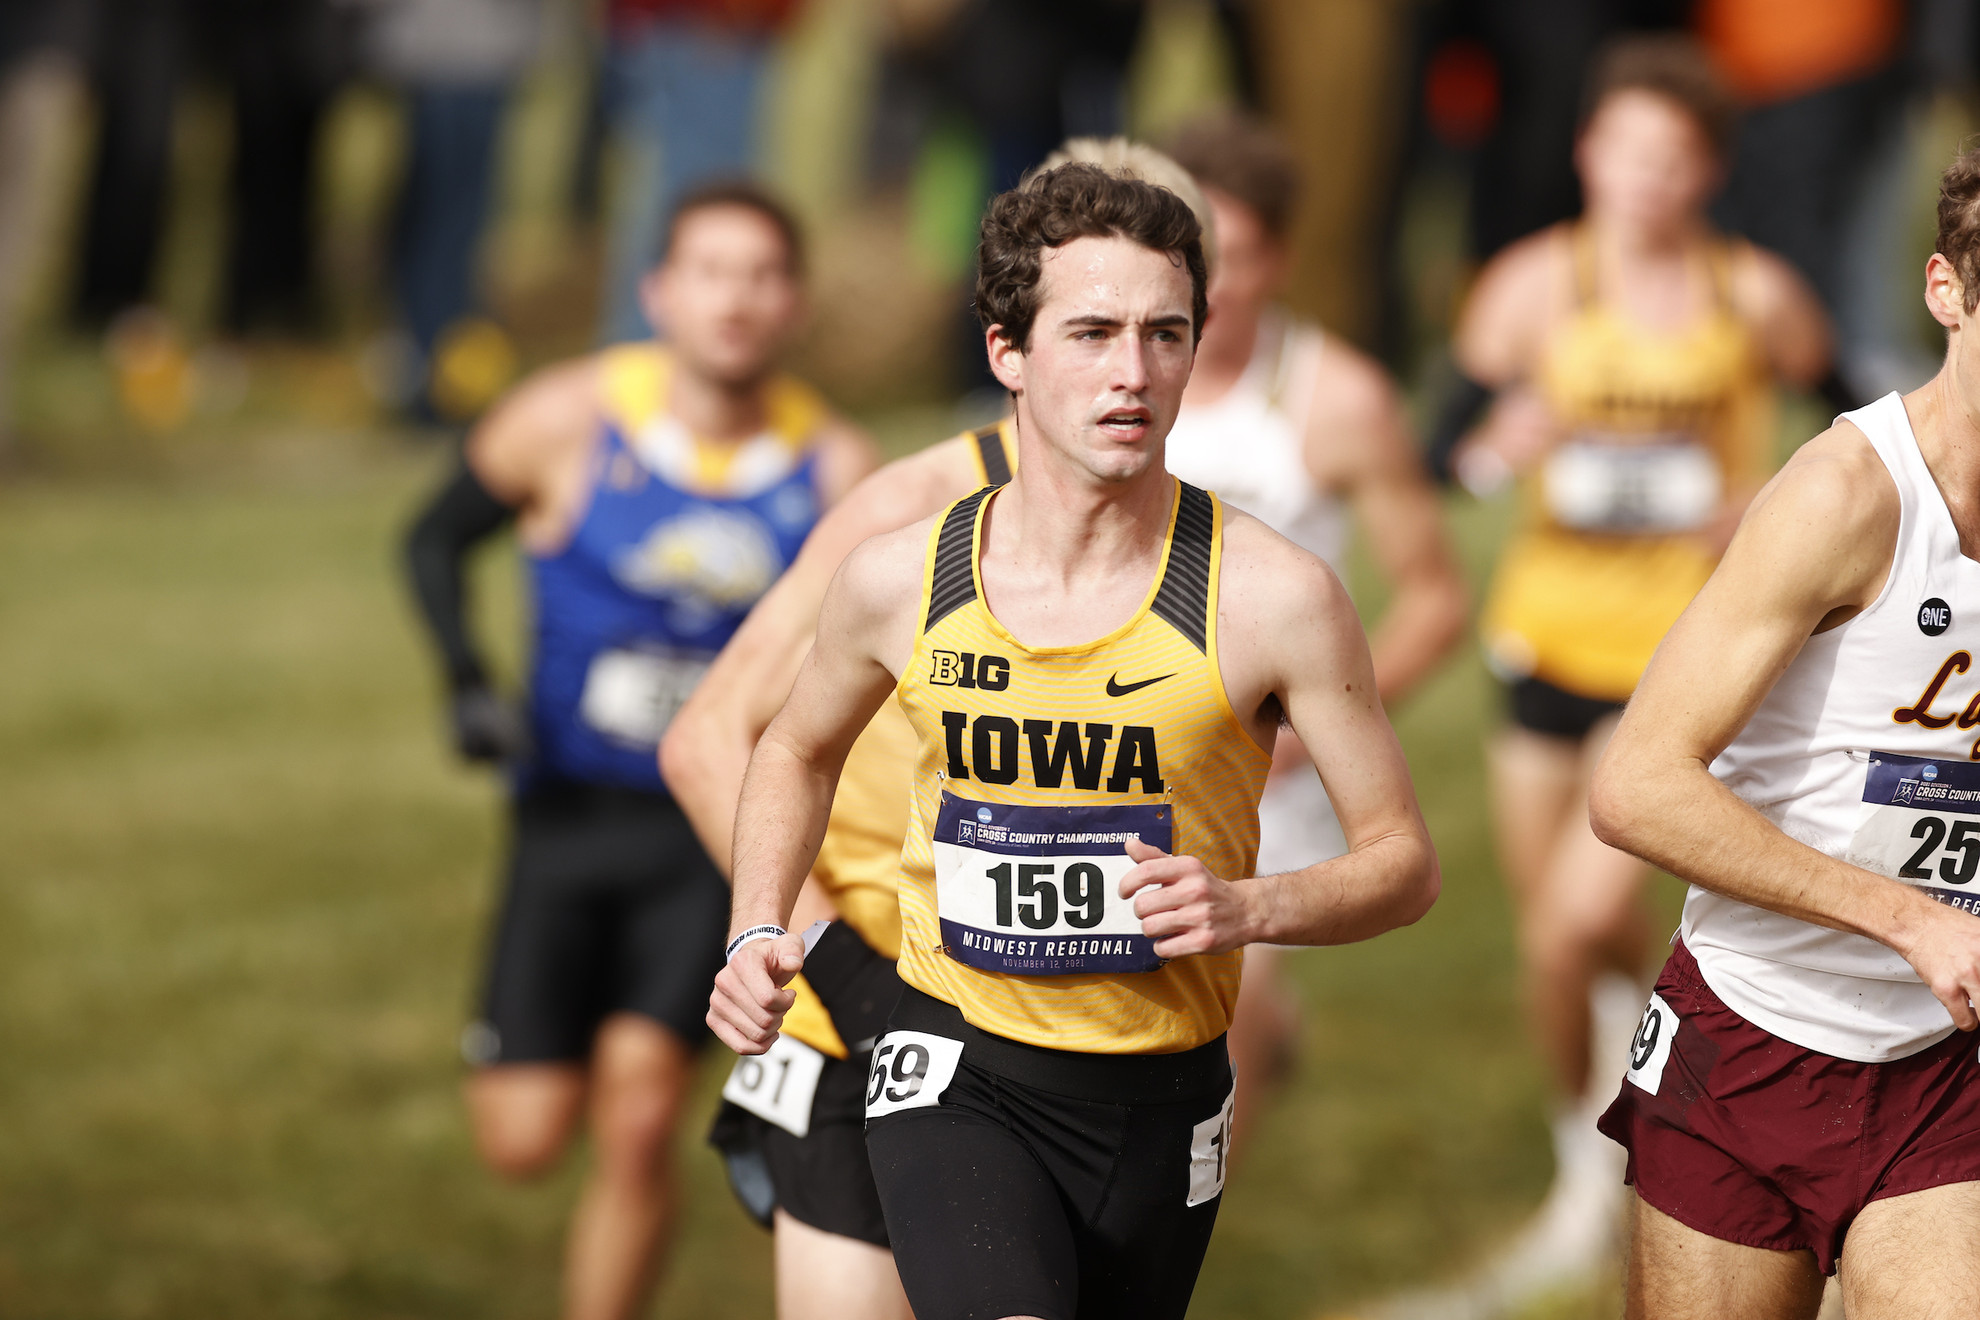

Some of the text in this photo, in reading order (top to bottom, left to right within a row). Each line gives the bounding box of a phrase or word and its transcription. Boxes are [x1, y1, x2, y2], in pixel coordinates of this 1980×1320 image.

[942, 711, 1165, 794] IOWA
[1916, 786, 1948, 799] CROSS
[977, 828, 1008, 842] CROSS
[1009, 832, 1055, 844] COUNTRY
[1056, 832, 1140, 844] CHAMPIONSHIPS
[1898, 816, 1980, 885] 25
[986, 862, 1105, 929] 159
[962, 931, 1133, 957] MIDWEST REGIONAL
[1003, 958, 1045, 968] NOVEMBER
[1065, 958, 1085, 968] 2021
